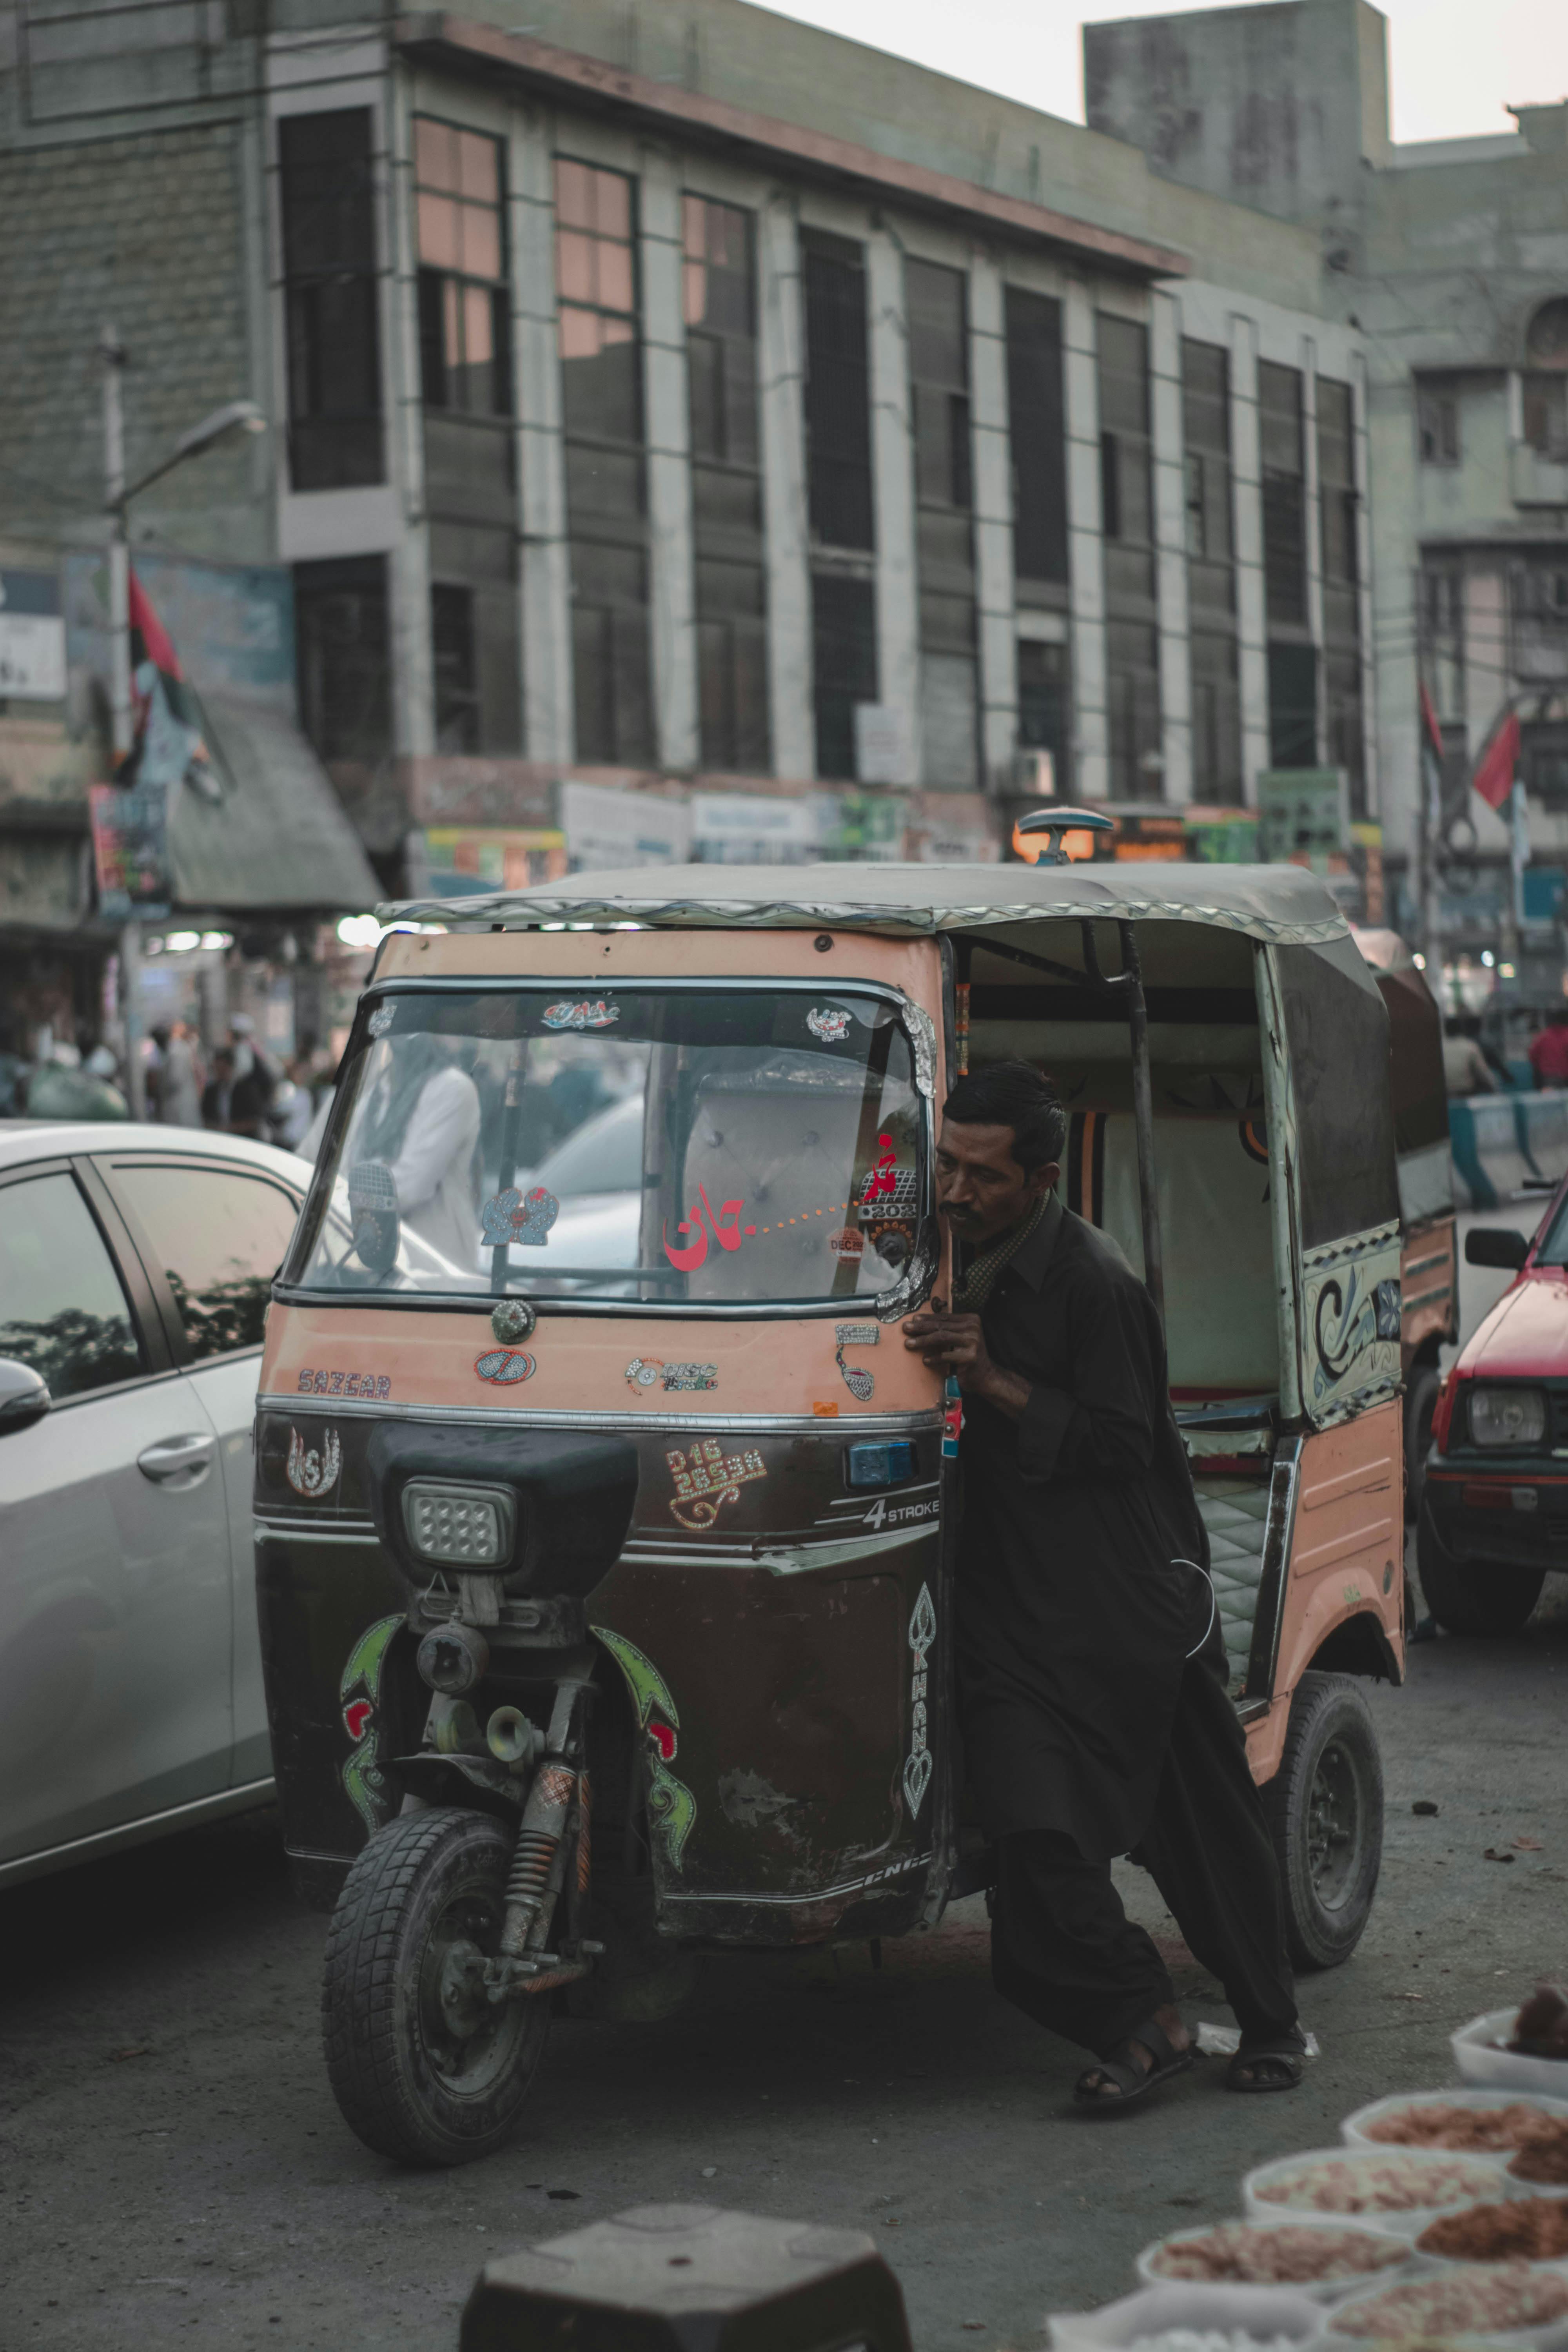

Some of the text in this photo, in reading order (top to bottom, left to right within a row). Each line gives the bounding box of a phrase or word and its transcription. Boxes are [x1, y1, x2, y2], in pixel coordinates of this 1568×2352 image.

[872, 1204, 916, 1218] 202
[831, 1240, 851, 1250] DEC
[660, 1363, 718, 1377] DISC
[298, 1368, 391, 1399] SAZGAR
[664, 1376, 719, 1391] Brake
[863, 1499, 940, 1529] 4 STROKE
[911, 1644, 928, 1754] KHAN
